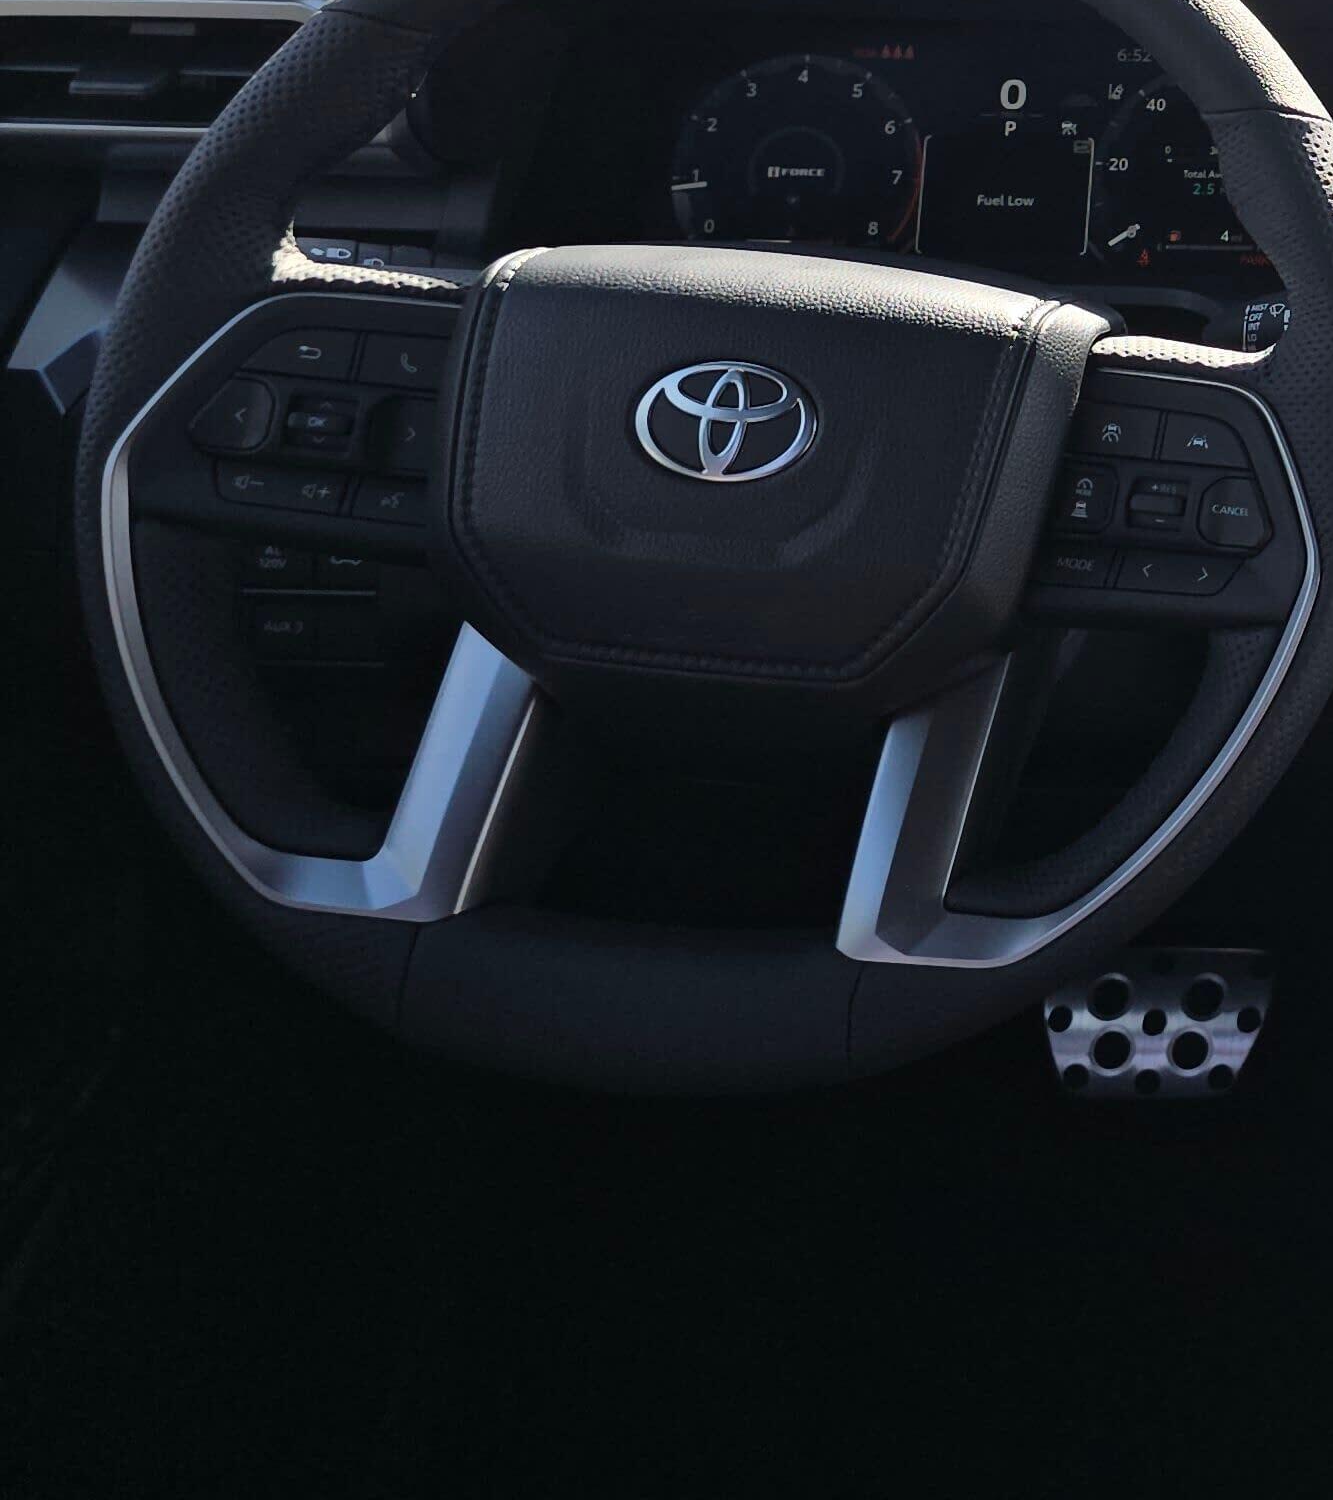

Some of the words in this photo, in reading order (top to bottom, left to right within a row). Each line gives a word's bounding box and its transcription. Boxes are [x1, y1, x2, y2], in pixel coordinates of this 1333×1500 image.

[798, 69, 808, 83] 4
[746, 83, 757, 97] 3
[852, 83, 863, 98] 5
[1000, 78, 1027, 110] 0
[1146, 98, 1167, 111] 40
[707, 117, 718, 132] 2
[884, 120, 896, 135] 6
[1004, 120, 1017, 136] P
[1108, 158, 1129, 171] 20
[892, 170, 902, 184] 7
[977, 194, 1005, 207] Fuel
[1008, 195, 1035, 207] Low
[704, 219, 715, 233] 0
[867, 221, 878, 235] 8
[1211, 503, 1249, 517] CANCEL
